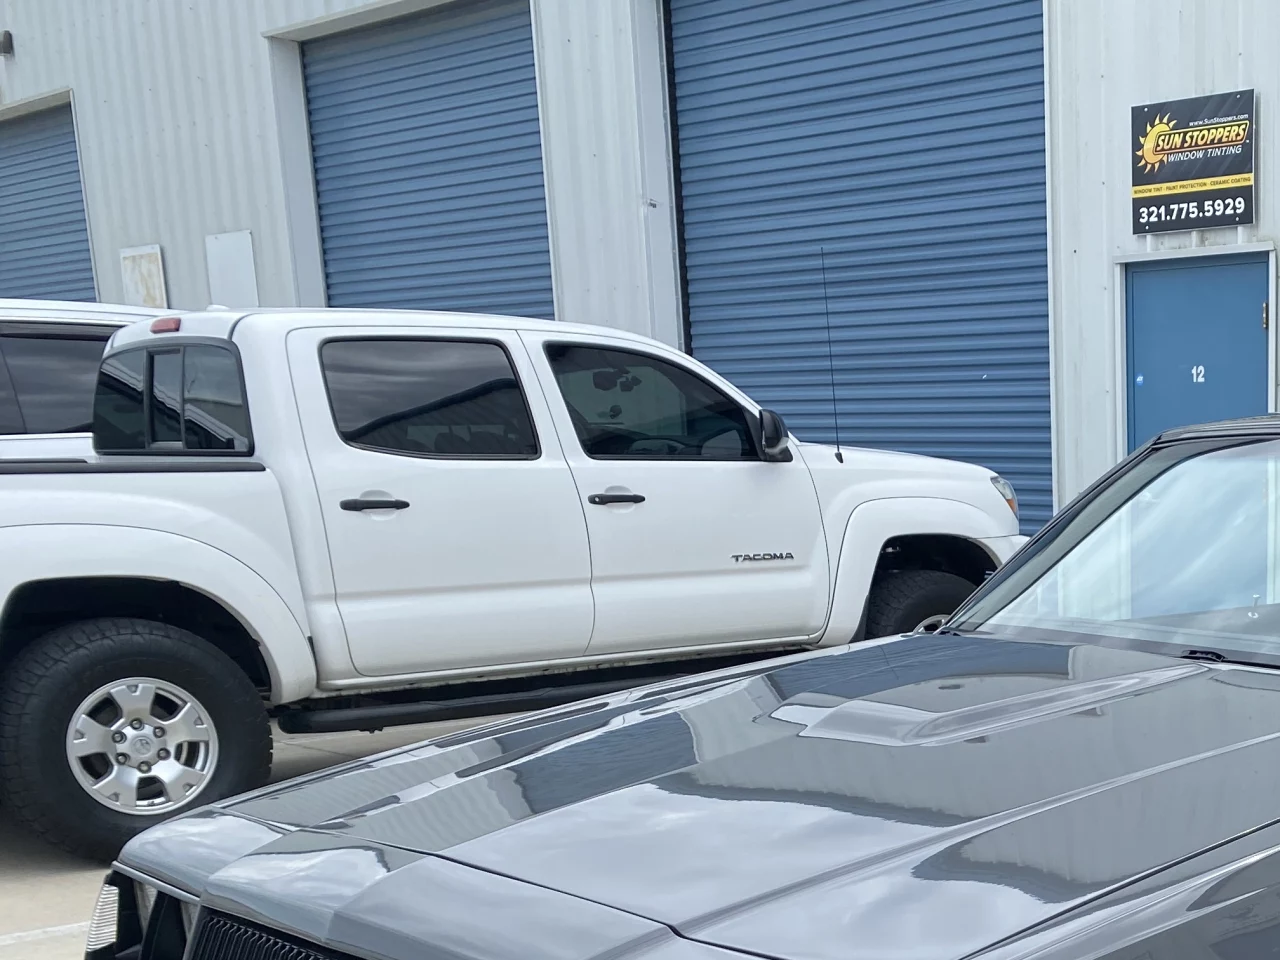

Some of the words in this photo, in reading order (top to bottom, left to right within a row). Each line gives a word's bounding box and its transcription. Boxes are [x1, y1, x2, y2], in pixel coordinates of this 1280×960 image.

[1156, 133, 1183, 151] SUN
[1184, 124, 1246, 148] STOPPERS
[1168, 151, 1204, 162] WINDOW
[1207, 145, 1242, 157] TINTING
[1179, 182, 1207, 190] PROTECTION
[1139, 197, 1245, 223] 321.775.5929
[1191, 365, 1205, 383] 12
[731, 552, 794, 562] TACOMA
